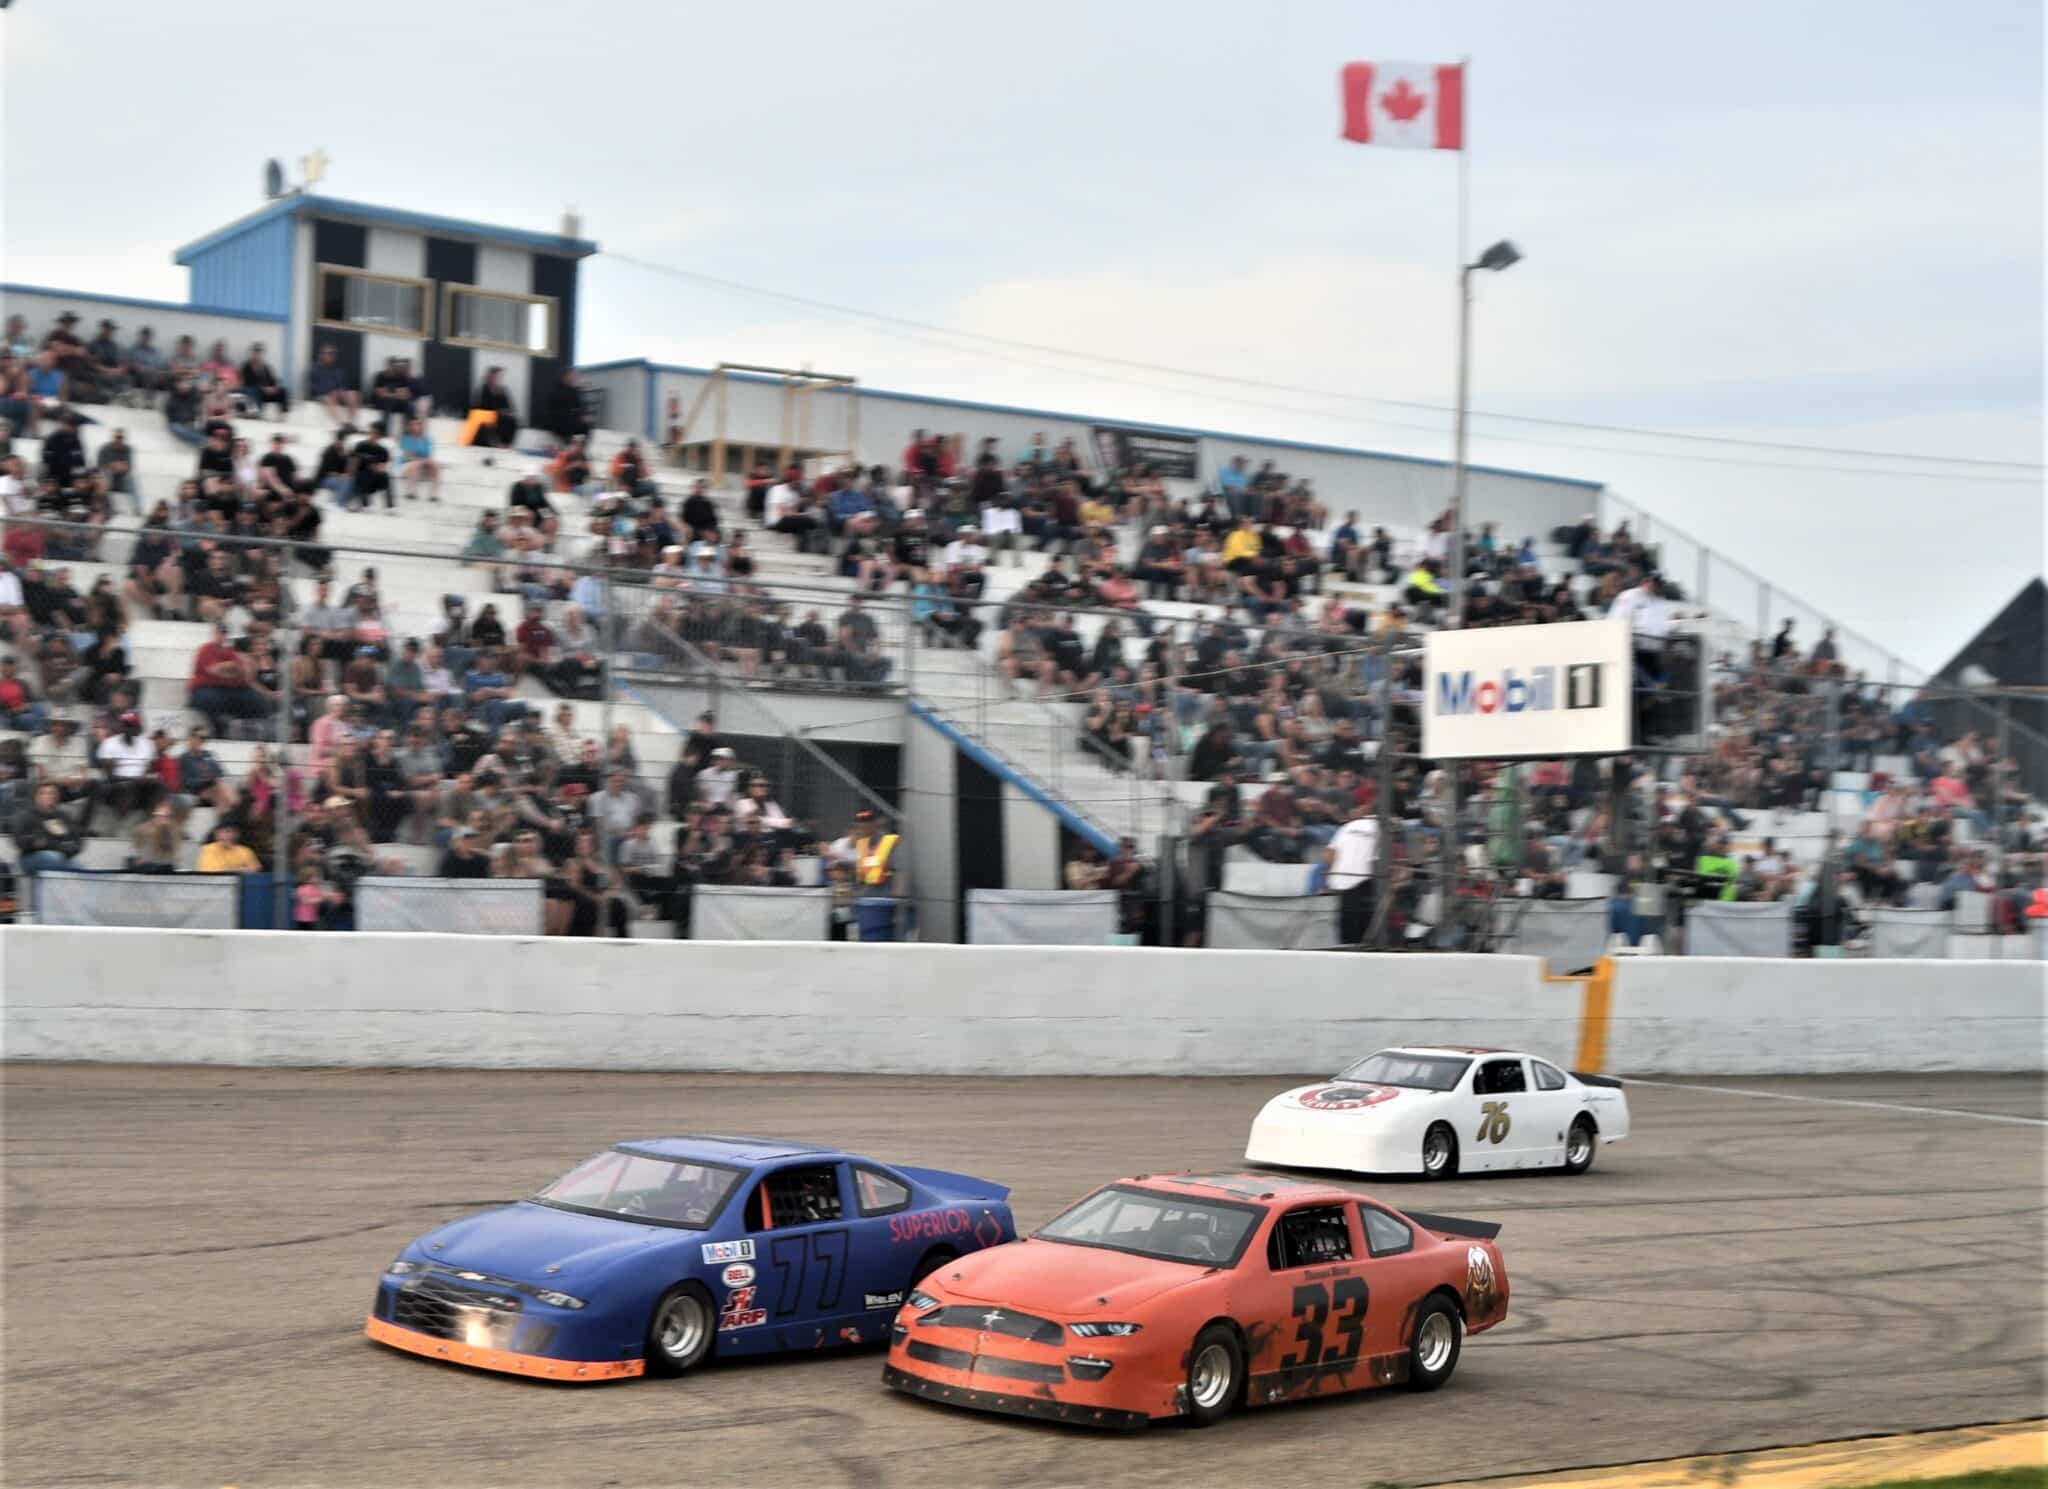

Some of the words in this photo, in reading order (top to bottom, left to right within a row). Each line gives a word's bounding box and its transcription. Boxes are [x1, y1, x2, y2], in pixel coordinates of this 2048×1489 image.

[1437, 665, 1556, 715] Mobil
[1567, 663, 1603, 709] 1
[1476, 1101, 1511, 1145] 76
[888, 1207, 972, 1244] SUPERIOR
[770, 1228, 849, 1317] 77
[721, 1311, 766, 1329] ARP
[1280, 1276, 1369, 1379] 33
